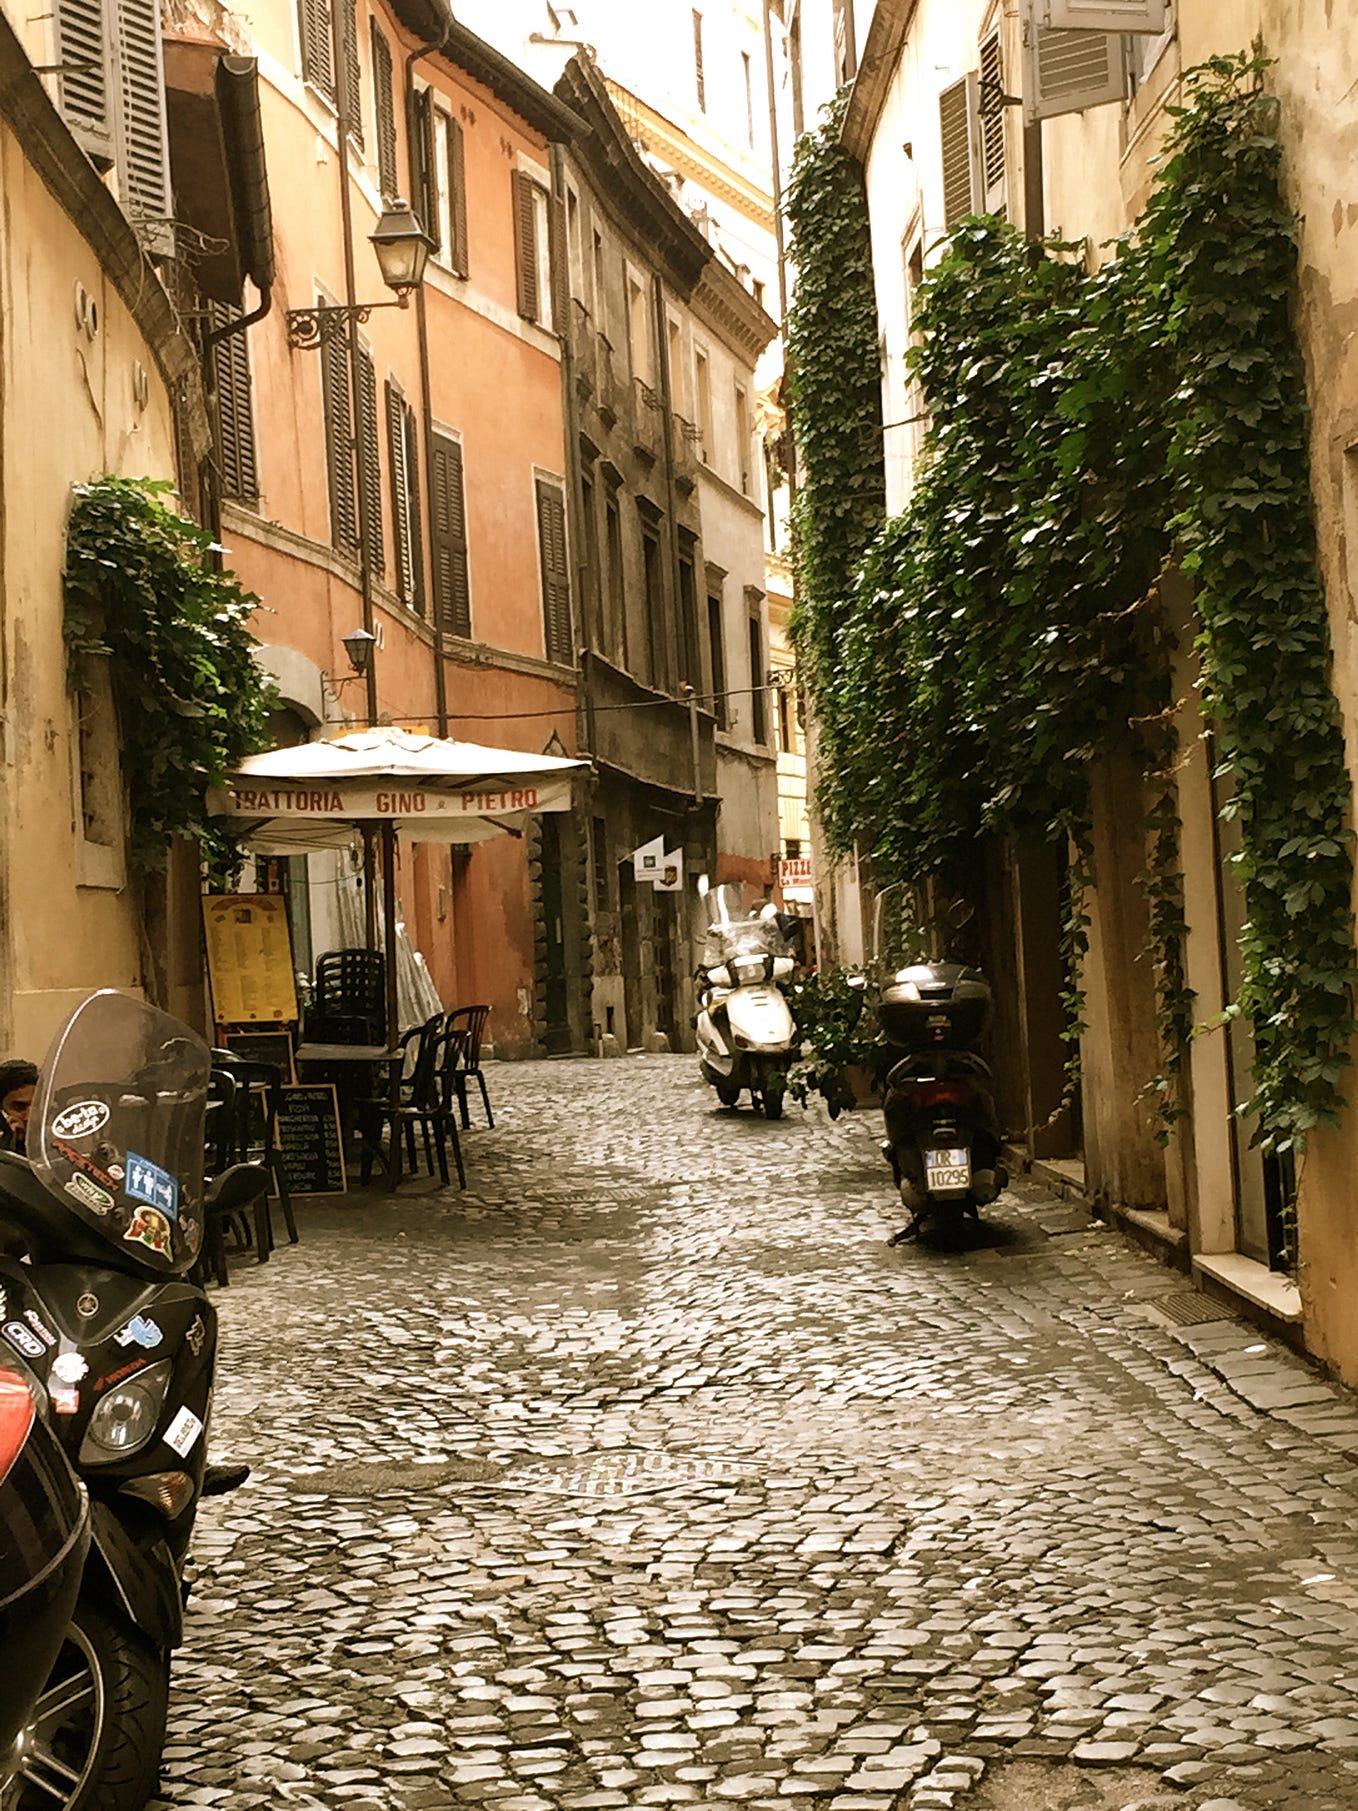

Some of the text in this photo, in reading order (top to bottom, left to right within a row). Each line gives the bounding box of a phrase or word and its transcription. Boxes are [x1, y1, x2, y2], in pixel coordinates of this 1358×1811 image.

[231, 789, 345, 811] TRATTORIA
[376, 792, 426, 813] GINO
[460, 788, 538, 811] PIETRO
[930, 1169, 969, 1187] 10295
[7, 1324, 42, 1355] CRD
